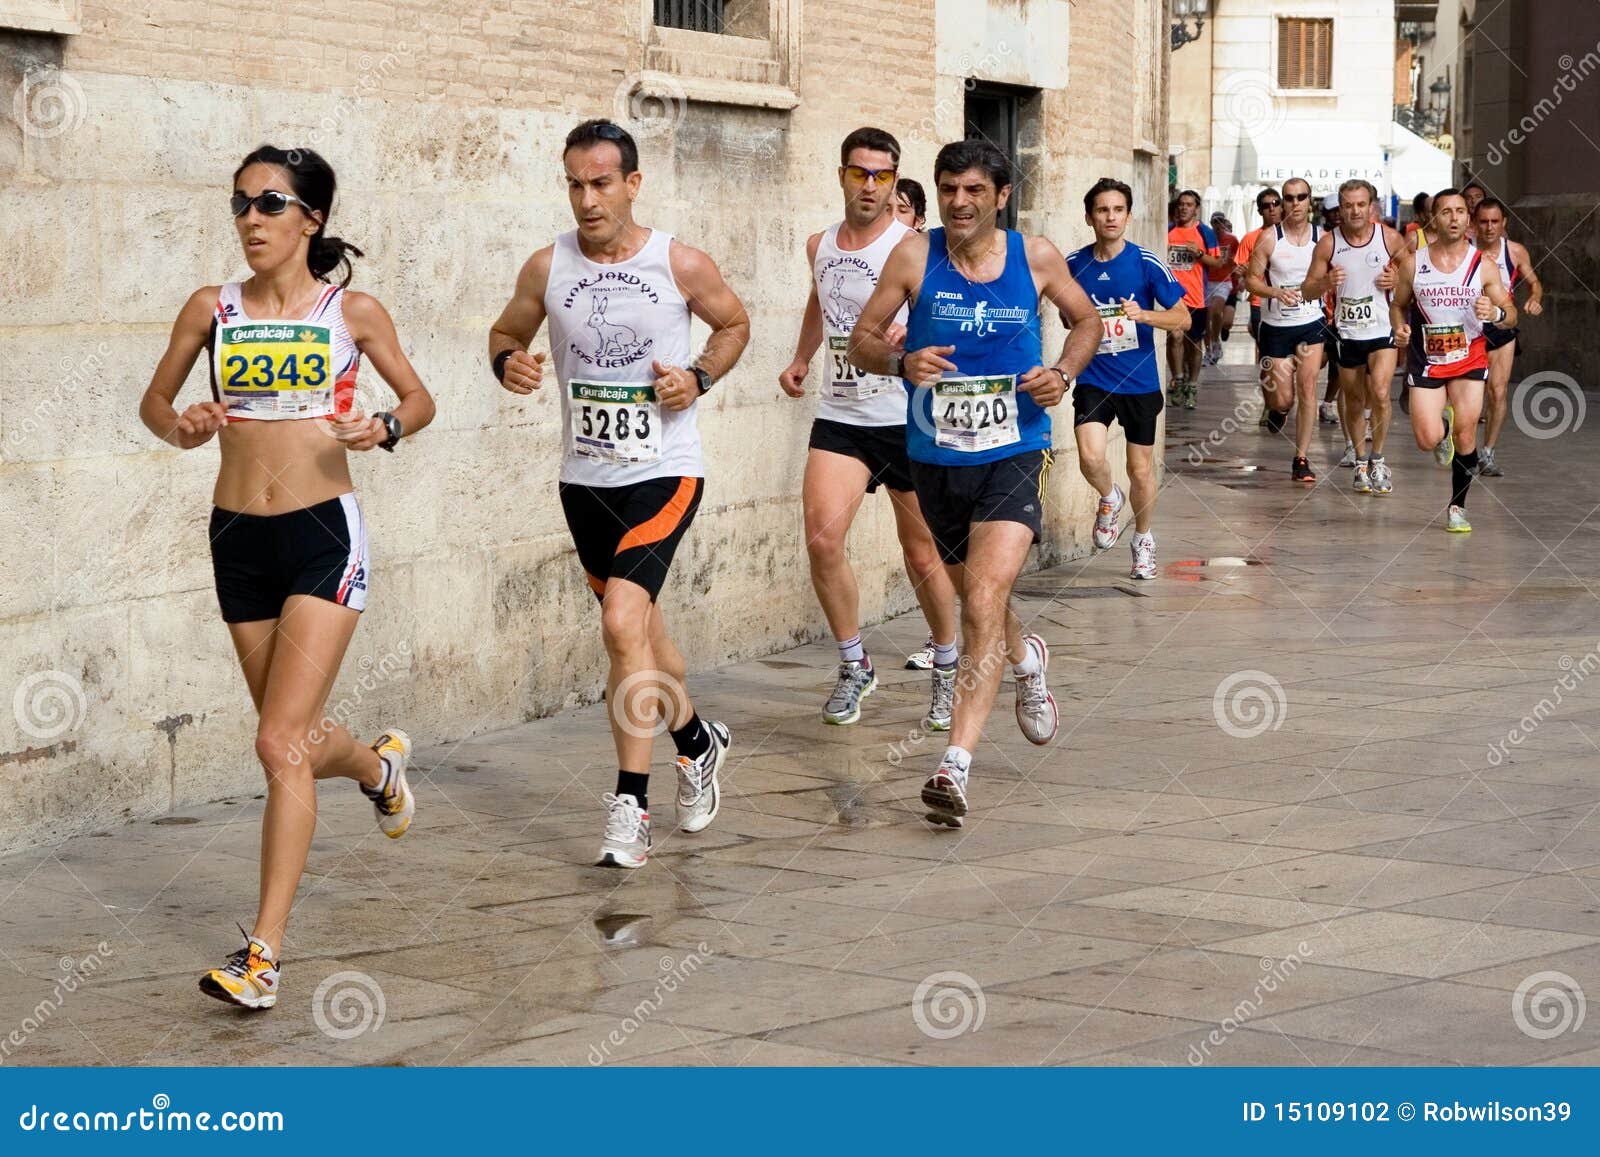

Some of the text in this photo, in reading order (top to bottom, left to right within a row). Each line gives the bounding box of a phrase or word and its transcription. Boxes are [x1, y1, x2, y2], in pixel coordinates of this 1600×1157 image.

[1260, 168, 1384, 179] HELADERIA
[1419, 286, 1476, 297] AMATEURS
[1431, 297, 1470, 307] SPORTS
[226, 353, 327, 388] 2343
[582, 405, 651, 441] 5283
[943, 397, 1008, 430] 4320
